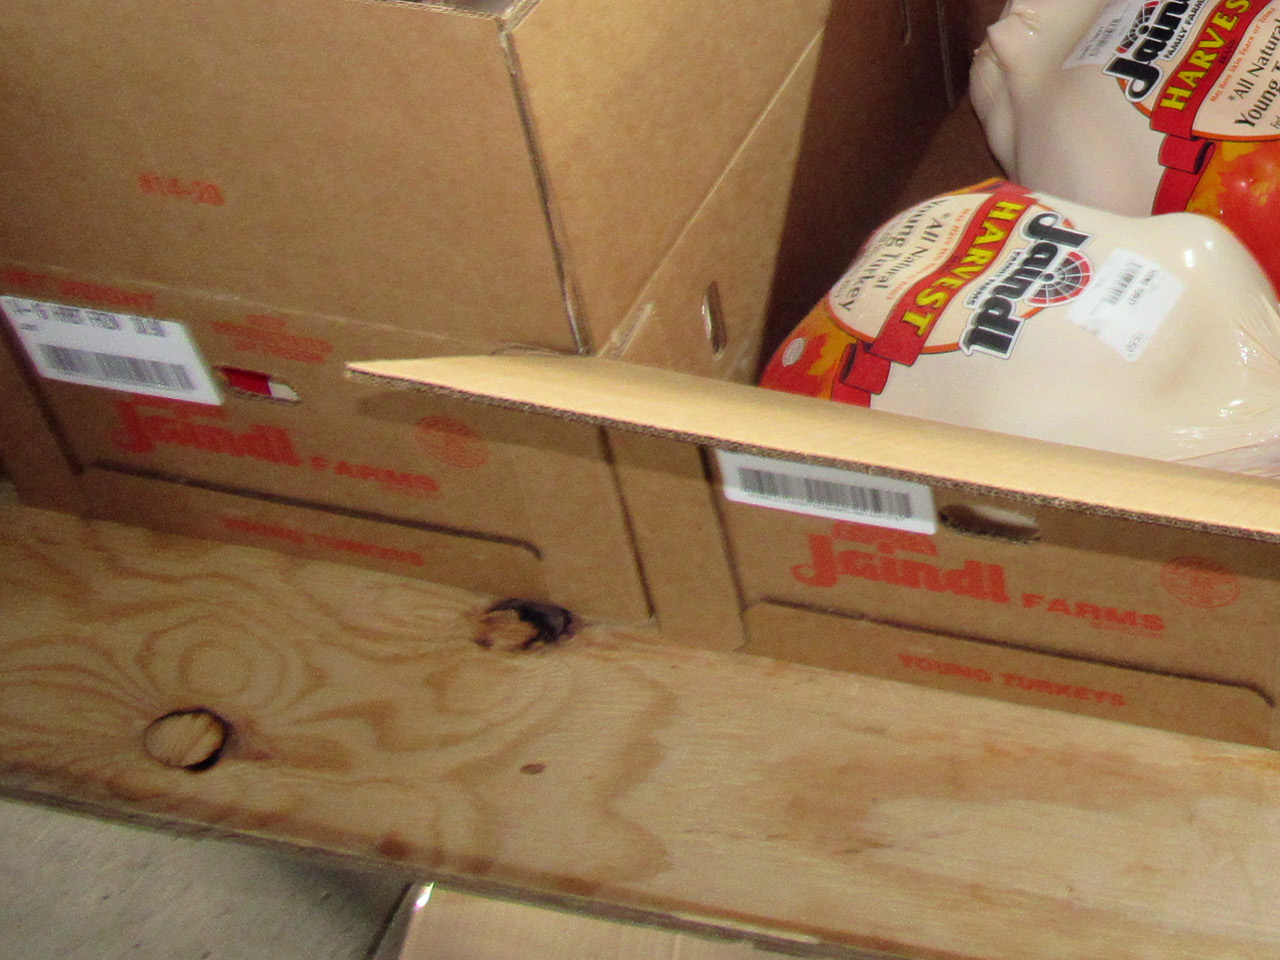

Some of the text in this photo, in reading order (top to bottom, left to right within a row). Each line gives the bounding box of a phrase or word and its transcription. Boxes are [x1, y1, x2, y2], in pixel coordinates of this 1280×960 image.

[1163, 26, 1187, 59] FAMILY
[1227, 55, 1243, 72] Skin
[1238, 34, 1255, 56] Tears
[837, 250, 899, 312] Turkey
[872, 245, 927, 290] Natural
[900, 200, 1022, 337] HARVEST
[963, 213, 1090, 354] Jaindl
[791, 534, 1165, 631] Jaindl FARMS
